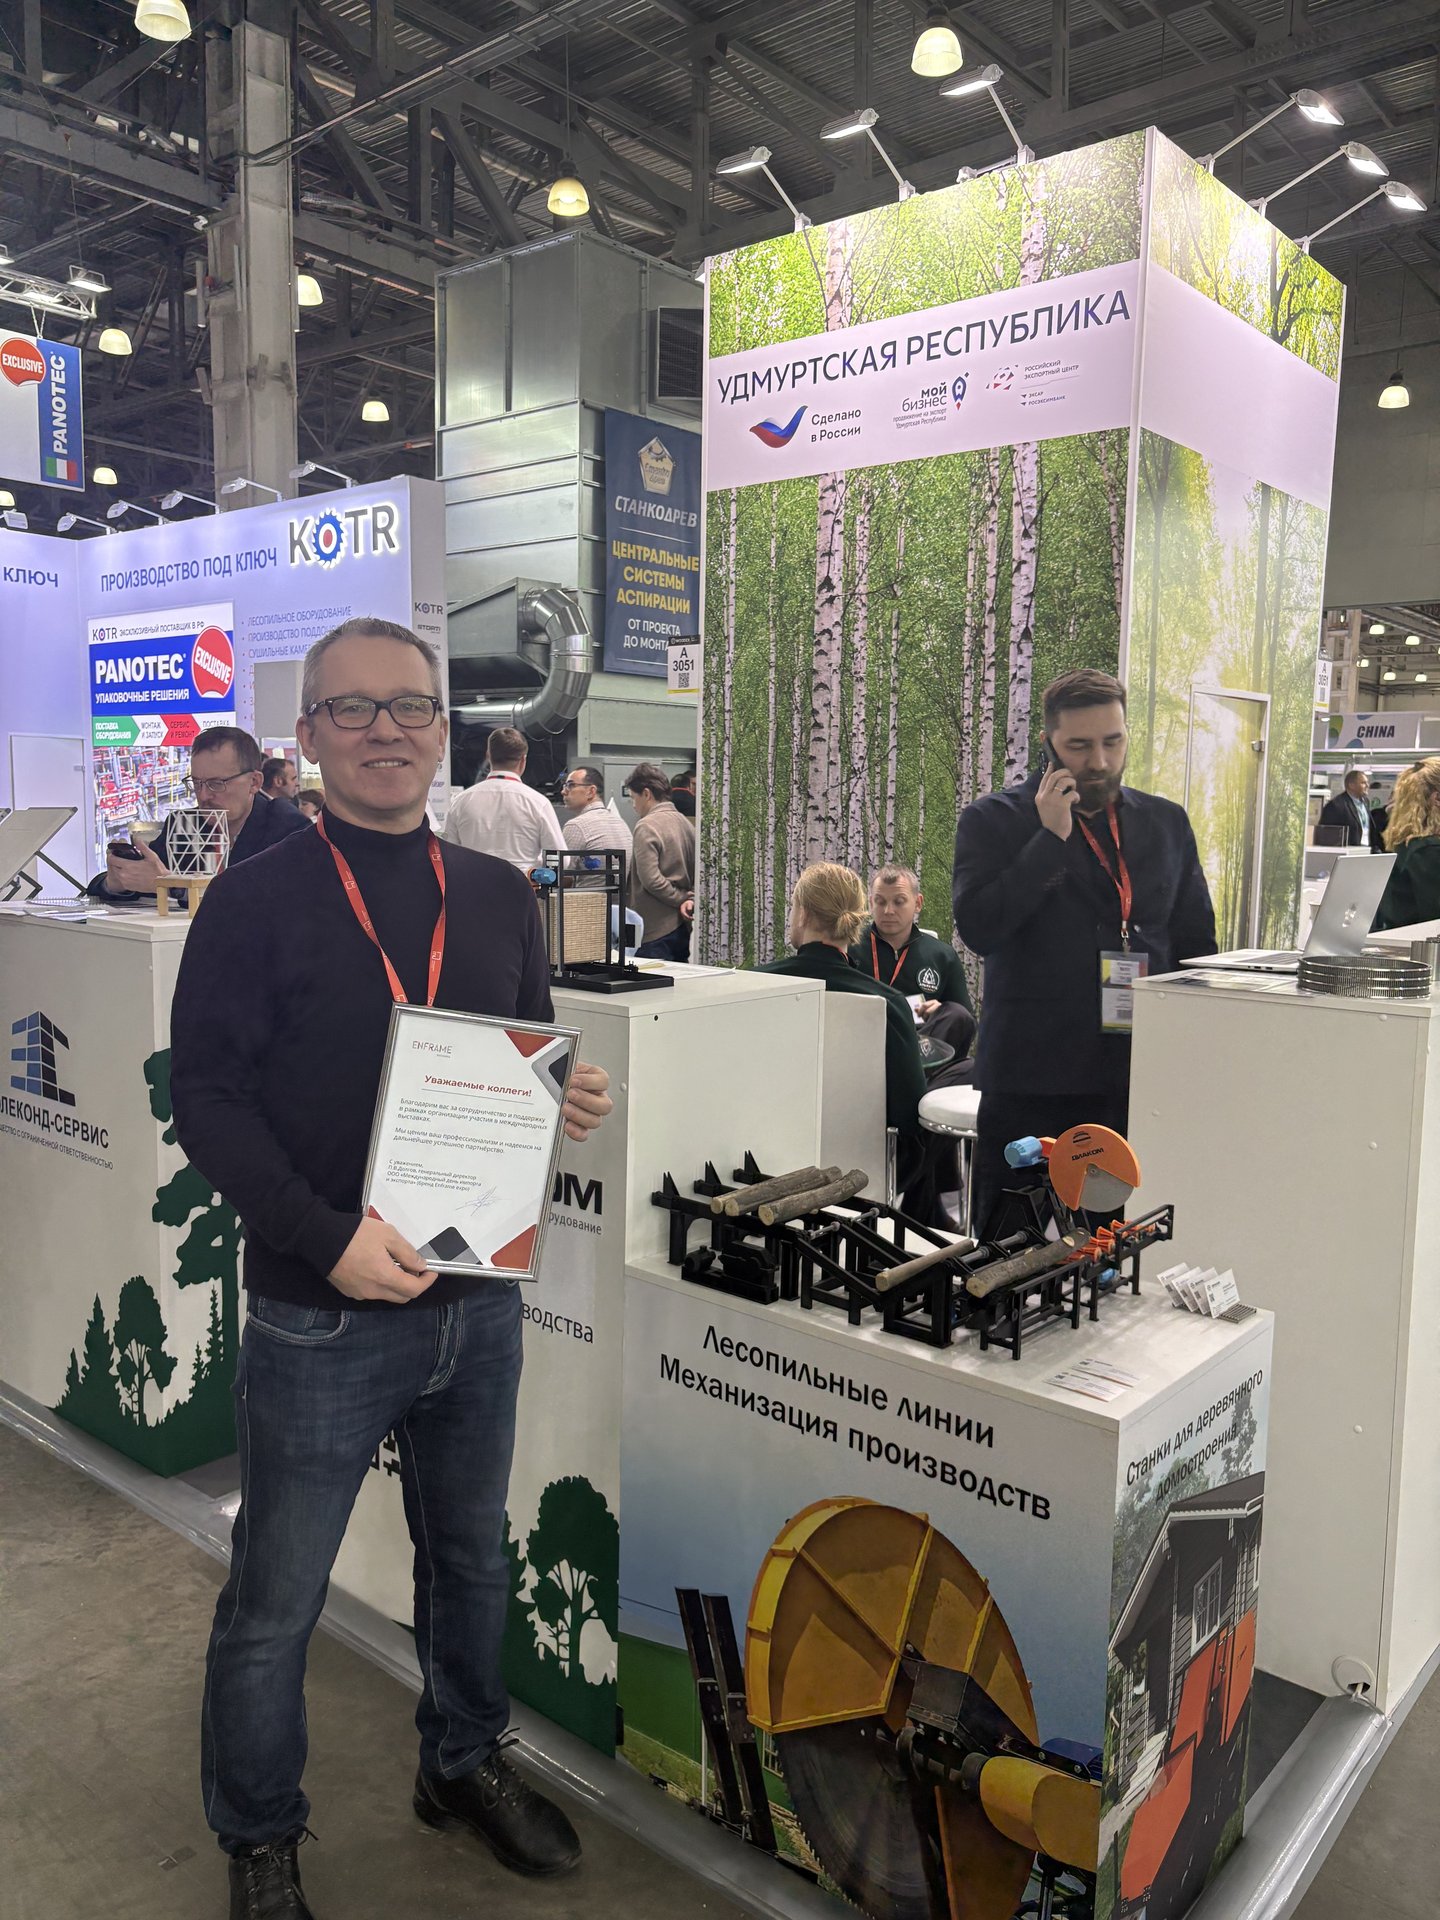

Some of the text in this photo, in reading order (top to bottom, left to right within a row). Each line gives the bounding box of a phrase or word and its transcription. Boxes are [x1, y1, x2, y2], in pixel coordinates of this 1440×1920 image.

[718, 289, 1131, 405] УДМУРТСКАЯ РЕСПУБЛИКА
[1, 350, 44, 375] EXCLUSIVE
[1024, 359, 1061, 373] РОССИЙСКИЙ
[1024, 364, 1079, 380] ЭКСПОРТНЫЙ ЦЕНТР
[921, 381, 947, 398] мой
[52, 354, 68, 455] PANOTEC
[902, 394, 947, 412] бизнес
[811, 407, 862, 426] Сделано
[811, 425, 862, 442] в России
[615, 495, 698, 528] СТАНКОДРЕВ
[288, 503, 400, 567] KOTR
[612, 540, 699, 572] ЦЕНТРАЛЬНЫЕ
[3, 566, 59, 589] КЛЮЧ
[101, 546, 278, 592] ПРОИЗВОДСТВО ПОД КЛЮЧ
[623, 566, 685, 592] СИСТЕМЫ
[414, 602, 443, 615] KOTR
[616, 588, 691, 615] АСПИРАЦИИ
[248, 605, 352, 627] ЛЕСОПИЛЬНОЕ ОБОРУДОВАНИЕ
[628, 618, 681, 636] ОТ ПРОЕКТА
[92, 627, 118, 642] KOTR
[119, 624, 160, 637] ЭКСКЛЮЗИВНЫЙ
[160, 622, 191, 633] ПОСТАВЩИК
[196, 621, 205, 629] РФ
[248, 628, 299, 642] ПРОИЗВОДСТВО
[248, 646, 289, 658] СУШИЛЬНЫЕ
[623, 634, 638, 649] ДО
[95, 653, 184, 684] PANOTEC
[194, 646, 232, 685] EXCLUSIVE
[673, 659, 694, 671] 3051
[95, 688, 189, 704] УПАКОВОЧНЫЕ РЕШЕНИЯ
[141, 721, 161, 729] МОНТАЖ
[1357, 725, 1395, 739] CHINA
[412, 1041, 453, 1055] ENFRAME
[425, 1075, 532, 1097] Уважаемые коллеги!
[398, 1113, 431, 1123] выставках.
[400, 1098, 438, 1109] Благодарим
[458, 1106, 507, 1118] сотрудничество
[513, 1114, 546, 1124] поддержку
[404, 1107, 426, 1116] рамках
[427, 1110, 468, 1121] организации
[468, 1116, 493, 1124] участия
[499, 1119, 548, 1131] международных
[0, 1096, 109, 1149] ЛЕКОНД-СЕРВИС
[393, 1135, 433, 1145] дальнейшее
[433, 1140, 465, 1149] успешное
[395, 1127, 406, 1135] Мы
[407, 1129, 427, 1137] ценим
[443, 1133, 498, 1146] профессионализм
[504, 1141, 534, 1150] надеемся
[21, 1131, 59, 1150] ОГРАНИЧЕННОЙ
[59, 1144, 114, 1170] ОТВЕТСТВЕННОСТЬЮ
[703, 1325, 996, 1449] Лесопильные линии
[659, 1353, 1052, 1522] Механизация производств
[1127, 1369, 1263, 1487] Станки для деревянного
[1156, 1422, 1238, 1504] домостроения
